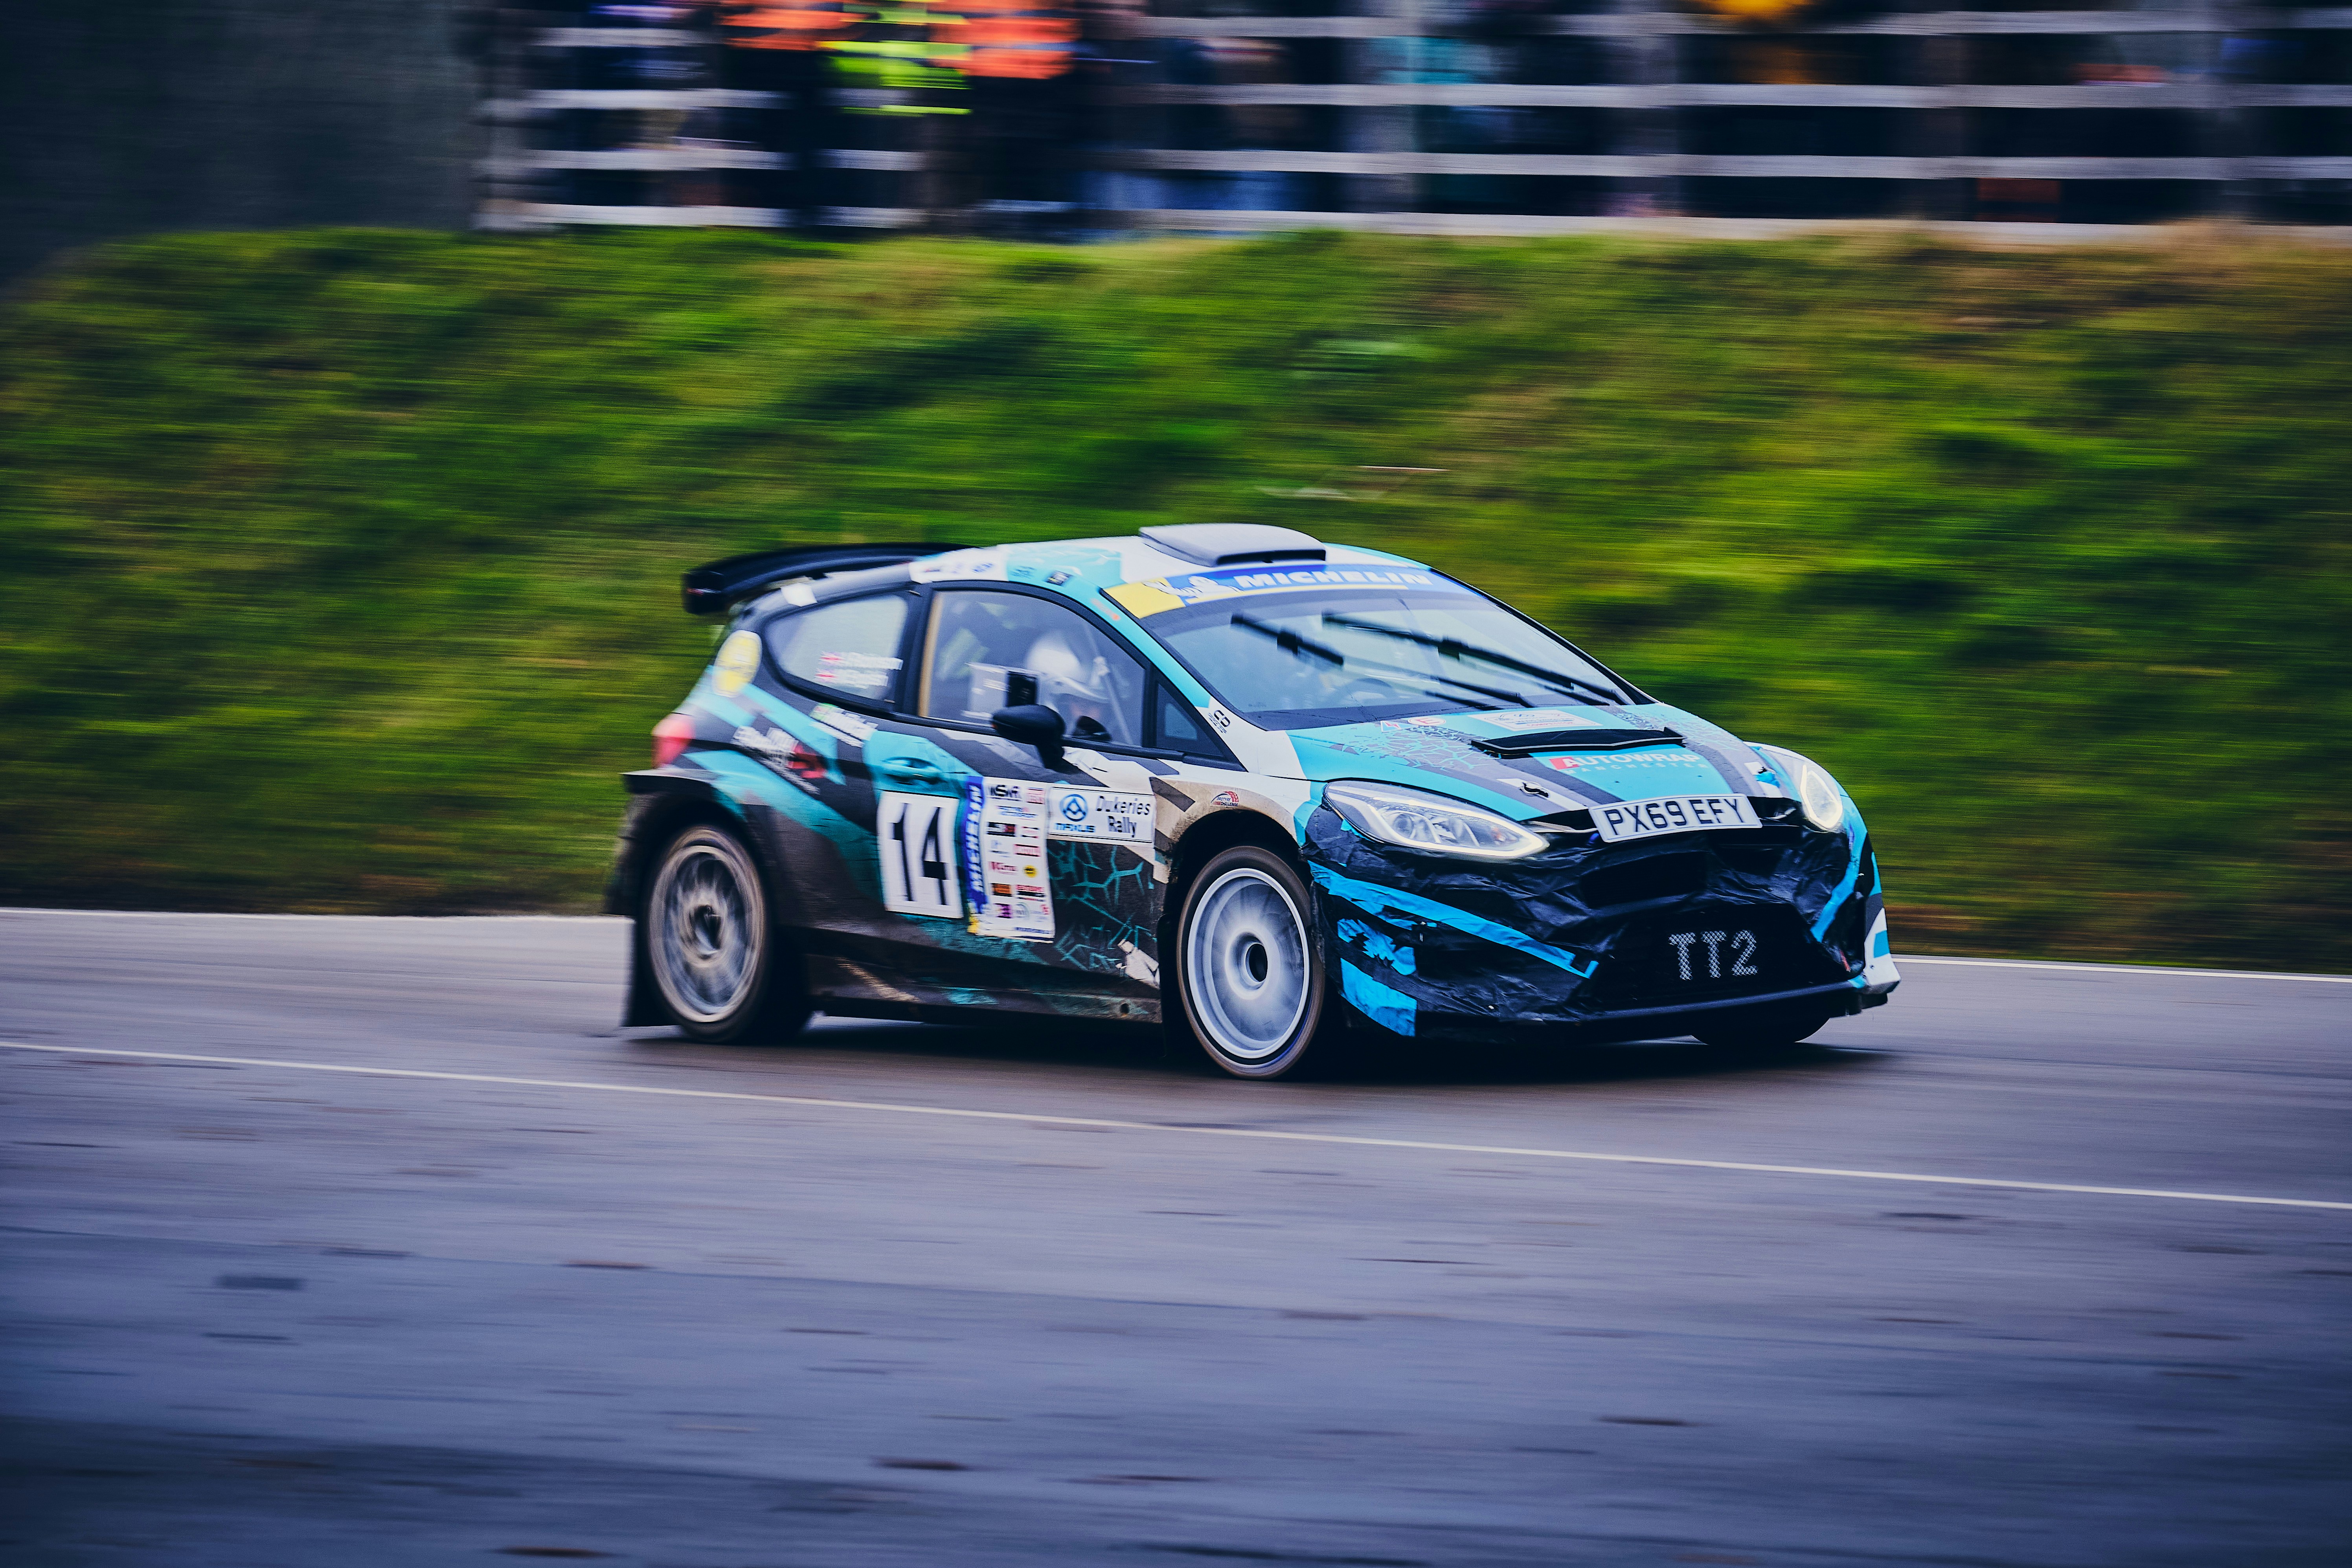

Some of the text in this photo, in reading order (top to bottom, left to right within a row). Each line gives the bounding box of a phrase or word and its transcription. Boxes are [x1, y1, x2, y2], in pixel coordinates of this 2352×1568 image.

[1233, 571, 1433, 588] MICHELIN
[1562, 754, 1701, 767] AUTOWRAP
[1564, 763, 1709, 774] MANCHESTER
[1096, 795, 1151, 815] Dukeries
[1107, 815, 1137, 838] Rally
[1603, 799, 1745, 835] PX69 EFY
[887, 802, 951, 905] 14
[1668, 929, 1758, 980] TT2
